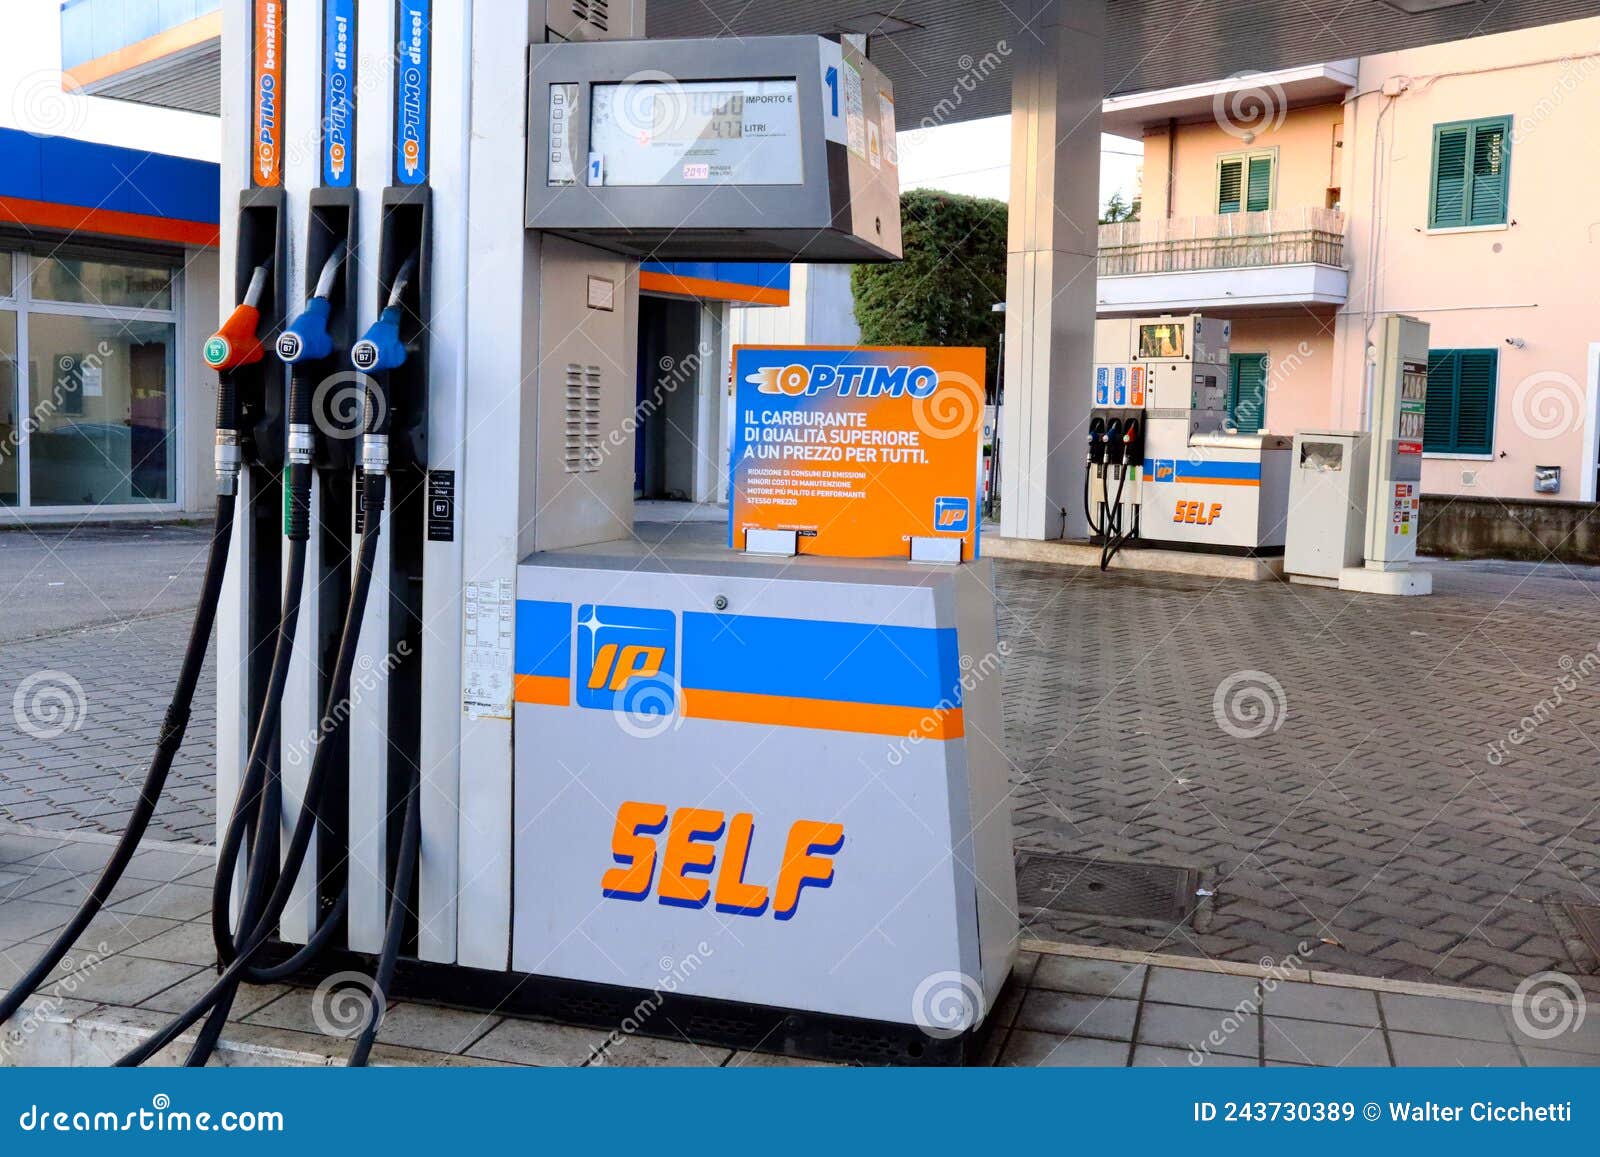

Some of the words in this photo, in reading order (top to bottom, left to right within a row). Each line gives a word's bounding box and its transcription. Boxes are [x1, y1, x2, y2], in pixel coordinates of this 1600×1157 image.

[264, 3, 275, 69] benzina
[334, 16, 347, 69] diesel
[409, 10, 421, 64] diesel
[745, 95, 785, 104] IMPORTO
[825, 66, 838, 117] 1
[260, 74, 275, 161] OPTIMO
[330, 72, 346, 162] OPTIMO
[403, 68, 420, 158] OPTIMO
[744, 124, 766, 133] LITRI
[592, 160, 600, 177] 1
[1224, 325, 1230, 337] 4
[284, 344, 293, 352] B7
[359, 353, 369, 361] B7
[779, 364, 939, 398] OPTIMO
[745, 410, 758, 425] IL
[761, 411, 867, 427] CARBURANTE
[744, 428, 760, 442] DI
[762, 424, 826, 446] QUALITÀ
[830, 429, 919, 446] SUPERIORE
[743, 446, 756, 459] A
[757, 446, 780, 460] UN
[783, 446, 842, 461] PREZZO
[845, 448, 877, 463] PER
[881, 449, 929, 464] TUTTI.
[747, 468, 781, 476] RIDUZIONE
[791, 470, 821, 478] CONSUMI
[832, 471, 866, 479] EMISSIONI
[747, 478, 771, 486] MINORI
[772, 479, 790, 487] COSTI
[800, 481, 852, 489] MANUTENZIONE
[747, 488, 775, 496] MOTORE
[787, 489, 810, 497] PULITO
[816, 491, 866, 499] PERFORMANTE
[747, 497, 771, 505] STESSO
[772, 498, 797, 506] PREZZO
[436, 504, 446, 512] B7
[1173, 500, 1223, 526] SELF
[938, 509, 967, 526] IP
[587, 643, 666, 692] IP
[601, 801, 845, 921] SELF
